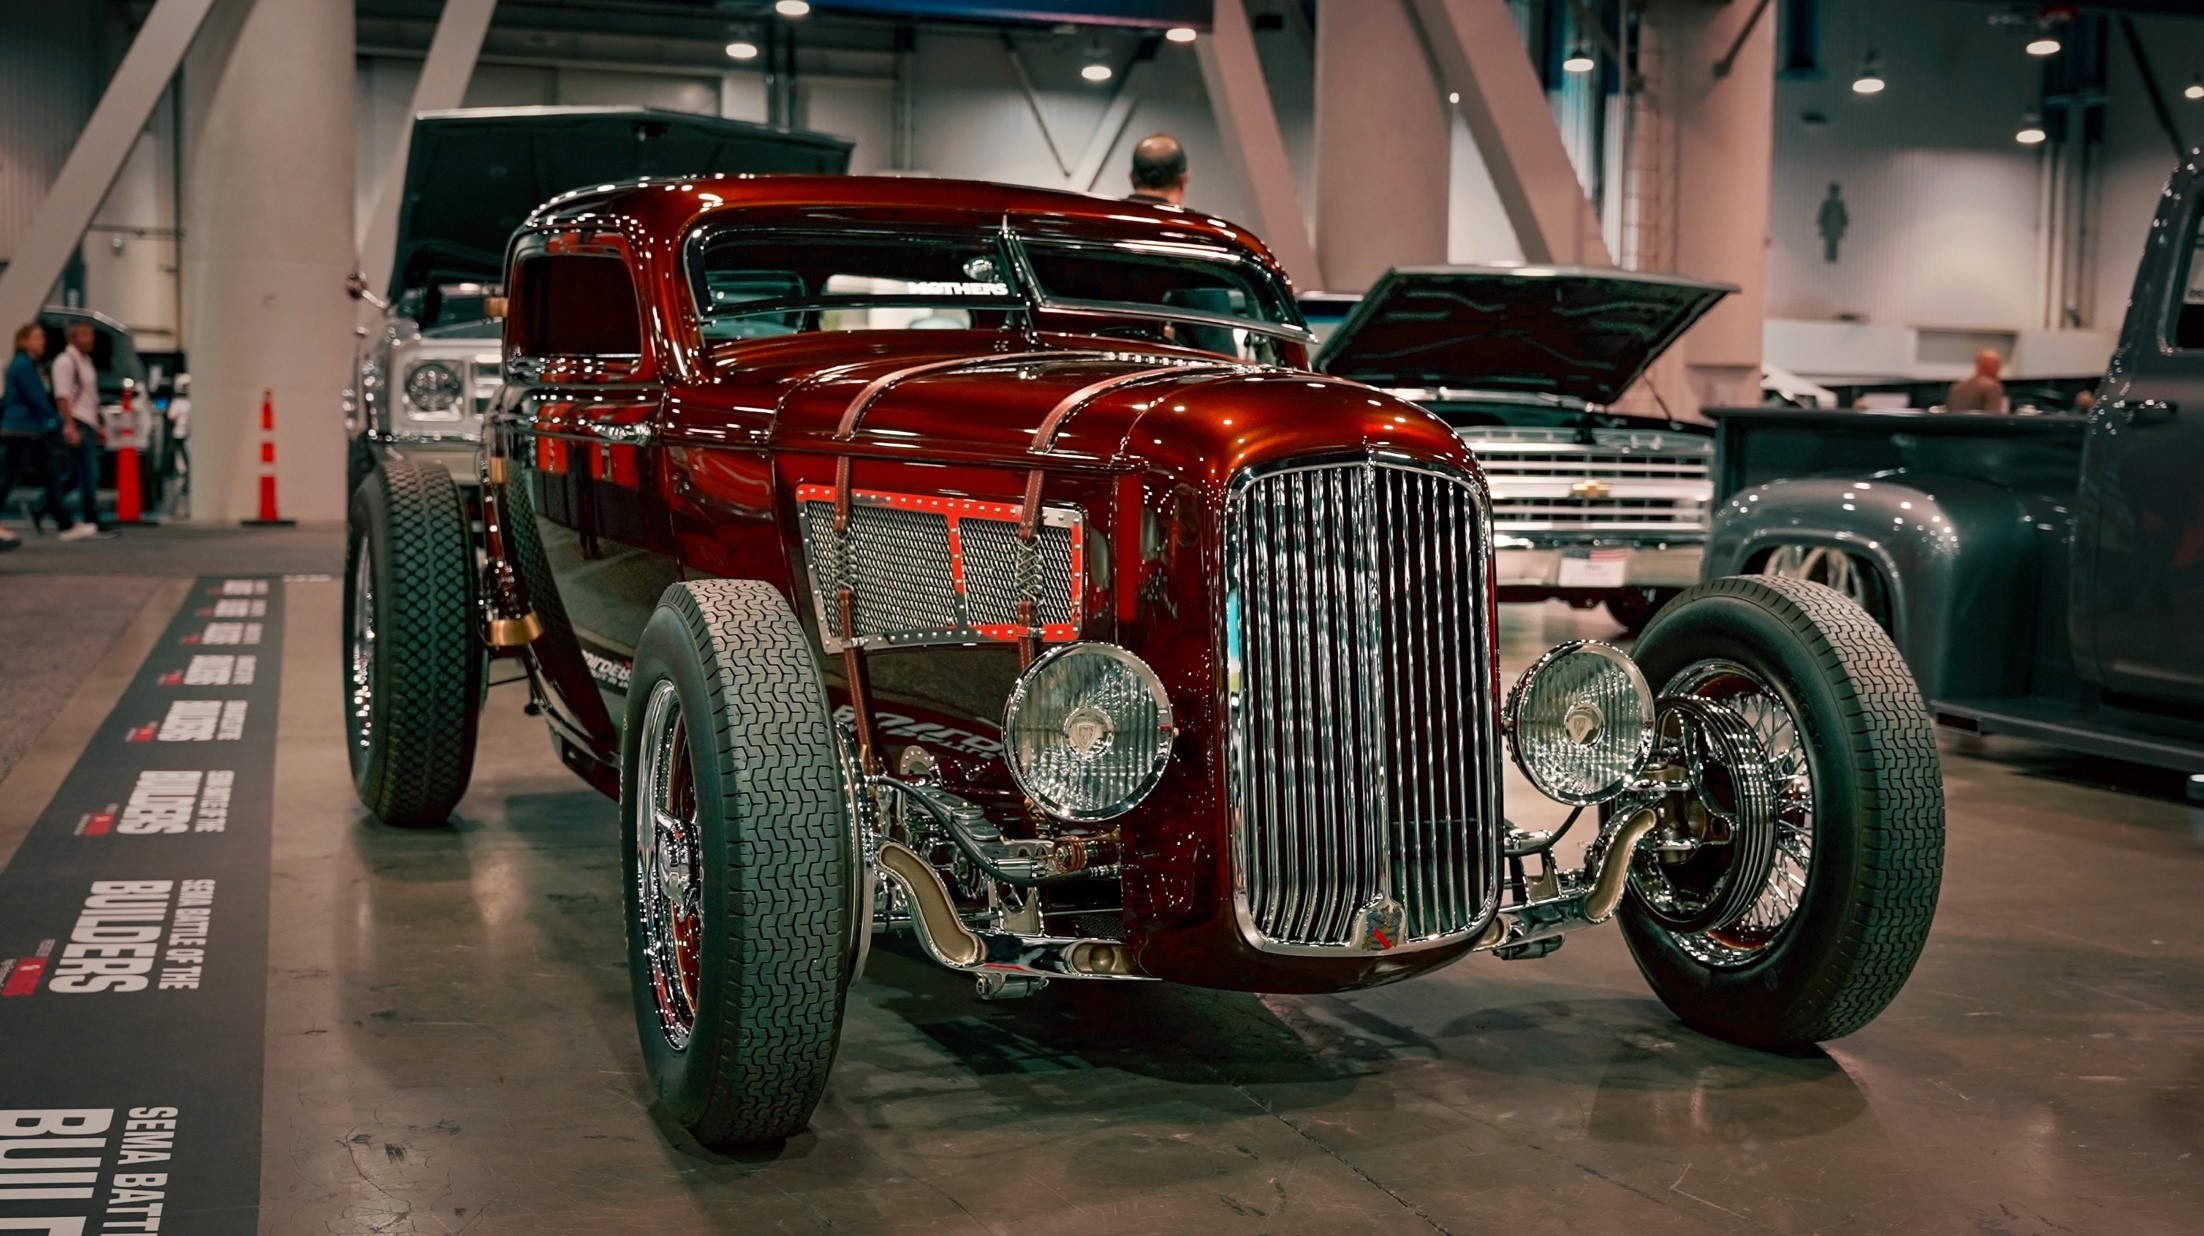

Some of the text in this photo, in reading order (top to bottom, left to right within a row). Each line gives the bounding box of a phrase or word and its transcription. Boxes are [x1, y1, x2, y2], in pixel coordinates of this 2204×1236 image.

[907, 281, 1009, 296] MOTHERS
[49, 880, 174, 993] BUILDERS
[158, 879, 216, 989] SEMA BATTLE OF THE
[100, 1107, 178, 1236] SEMA BATT
